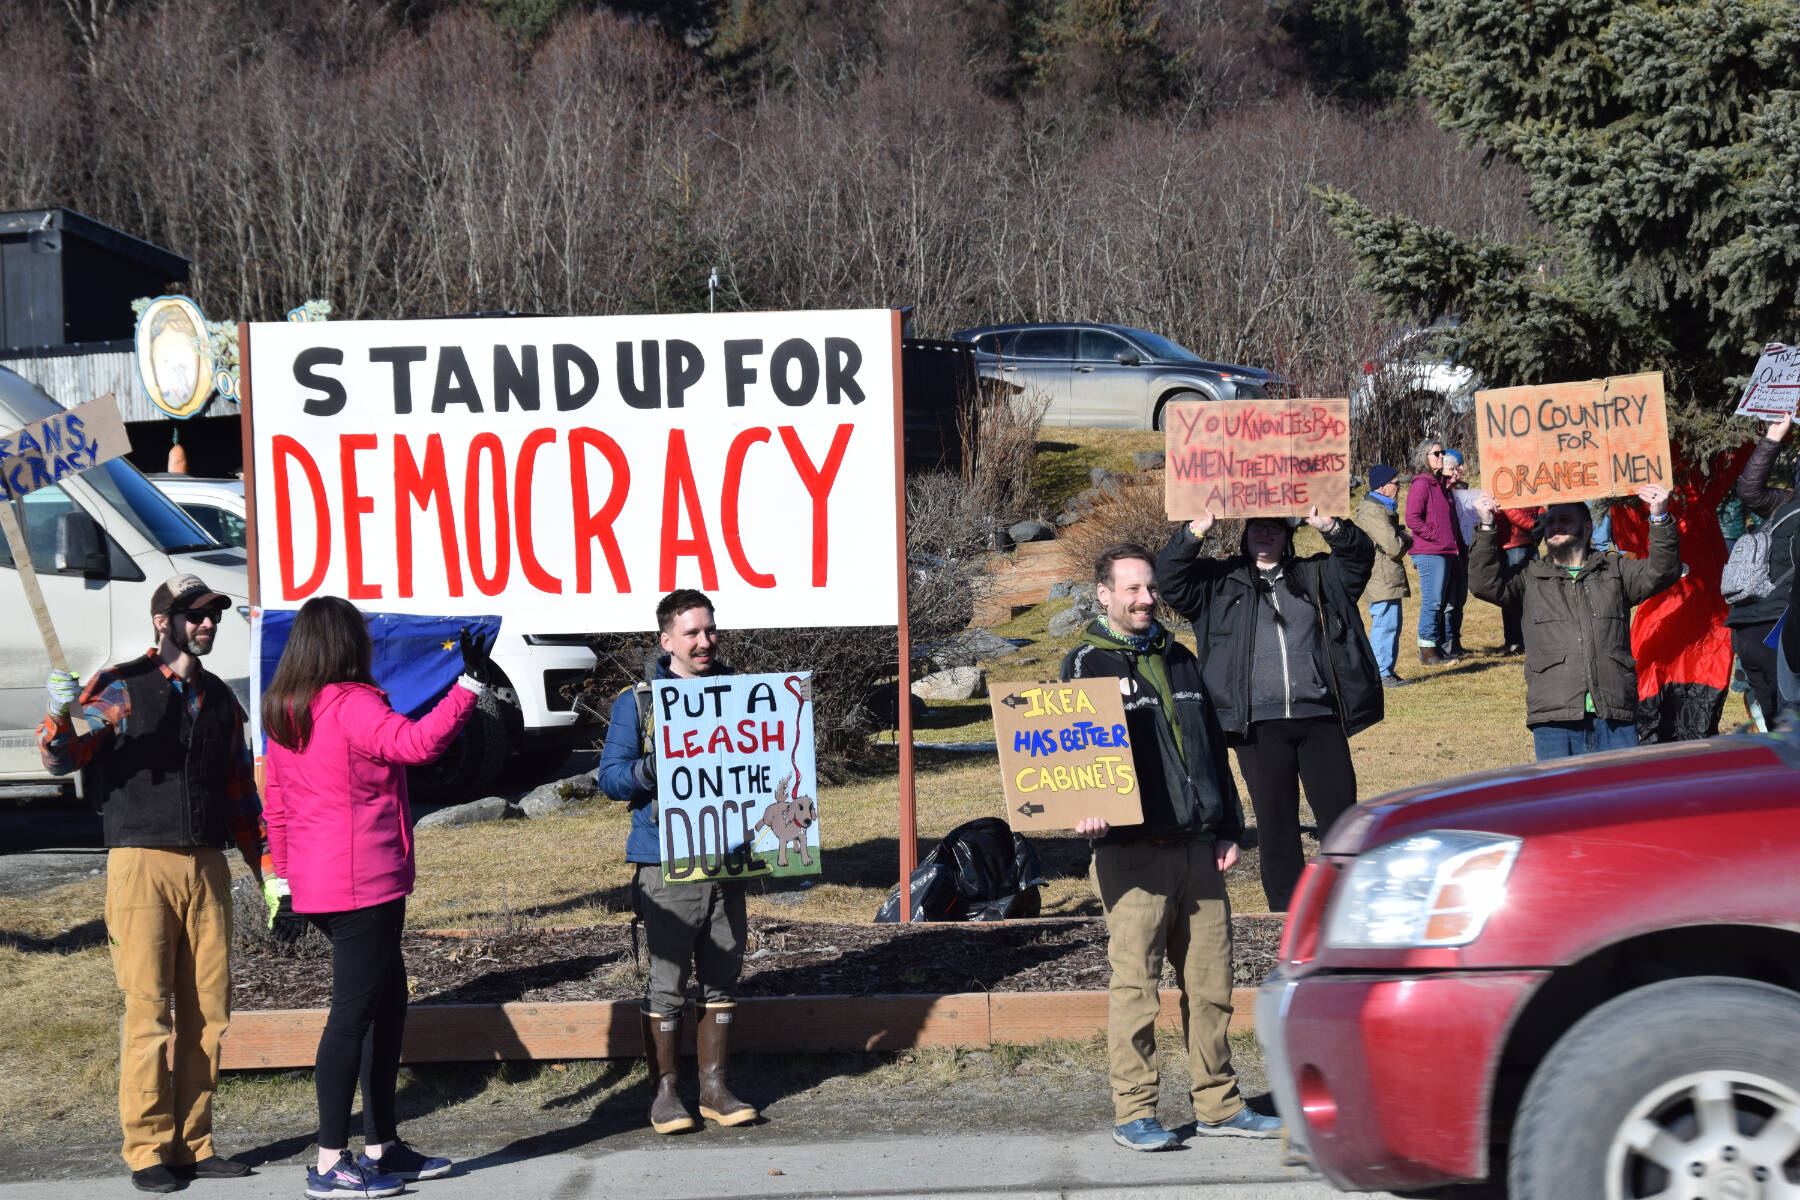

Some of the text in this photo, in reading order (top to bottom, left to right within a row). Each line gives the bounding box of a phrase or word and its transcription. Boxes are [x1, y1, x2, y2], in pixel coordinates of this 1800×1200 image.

[292, 343, 599, 417] STAND
[616, 339, 705, 410] UP
[724, 337, 866, 408] FOR
[1486, 394, 1648, 438] NO COUNTRY
[1557, 430, 1600, 452] FOR
[1170, 446, 1236, 481] WHEN
[1492, 452, 1663, 500] ORANGE MEN
[271, 423, 856, 601] DEMOCRACY
[660, 682, 777, 721] PUT A
[1020, 687, 1097, 718] IKEA
[662, 718, 785, 760] LEASH
[1014, 721, 1130, 757] HAS BETTER
[671, 763, 773, 800] ON THE
[1015, 756, 1135, 795] CABINETS
